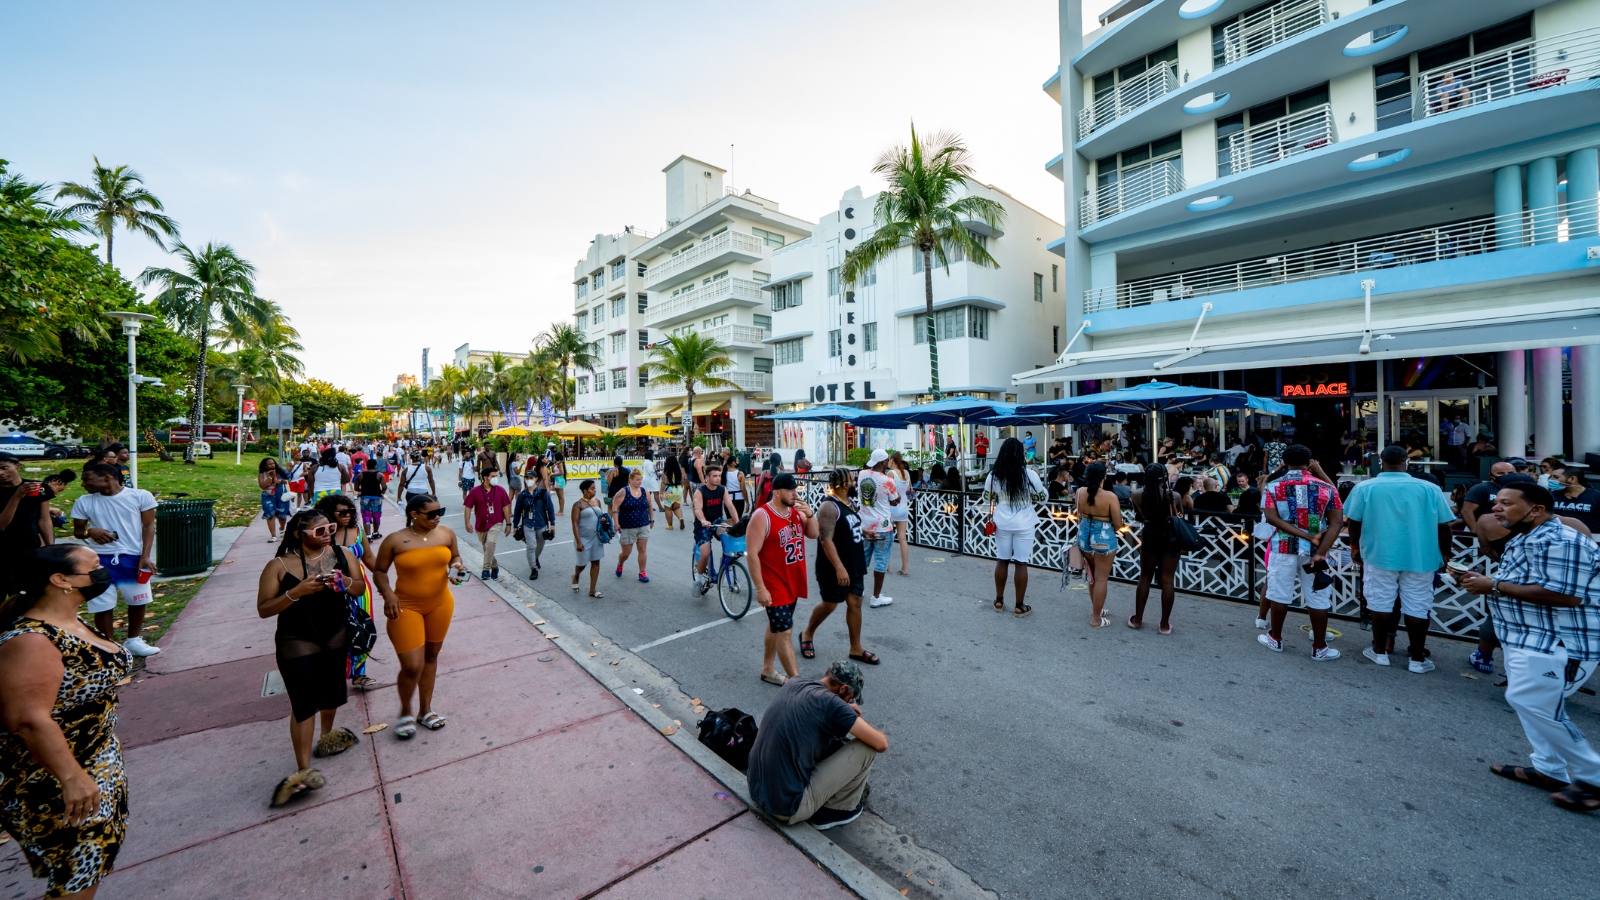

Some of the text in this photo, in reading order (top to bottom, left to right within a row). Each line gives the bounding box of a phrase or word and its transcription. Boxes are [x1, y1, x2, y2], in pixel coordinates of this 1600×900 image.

[844, 207, 857, 366] CORESS
[1283, 383, 1348, 396] PALACE
[784, 539, 804, 565] 23
